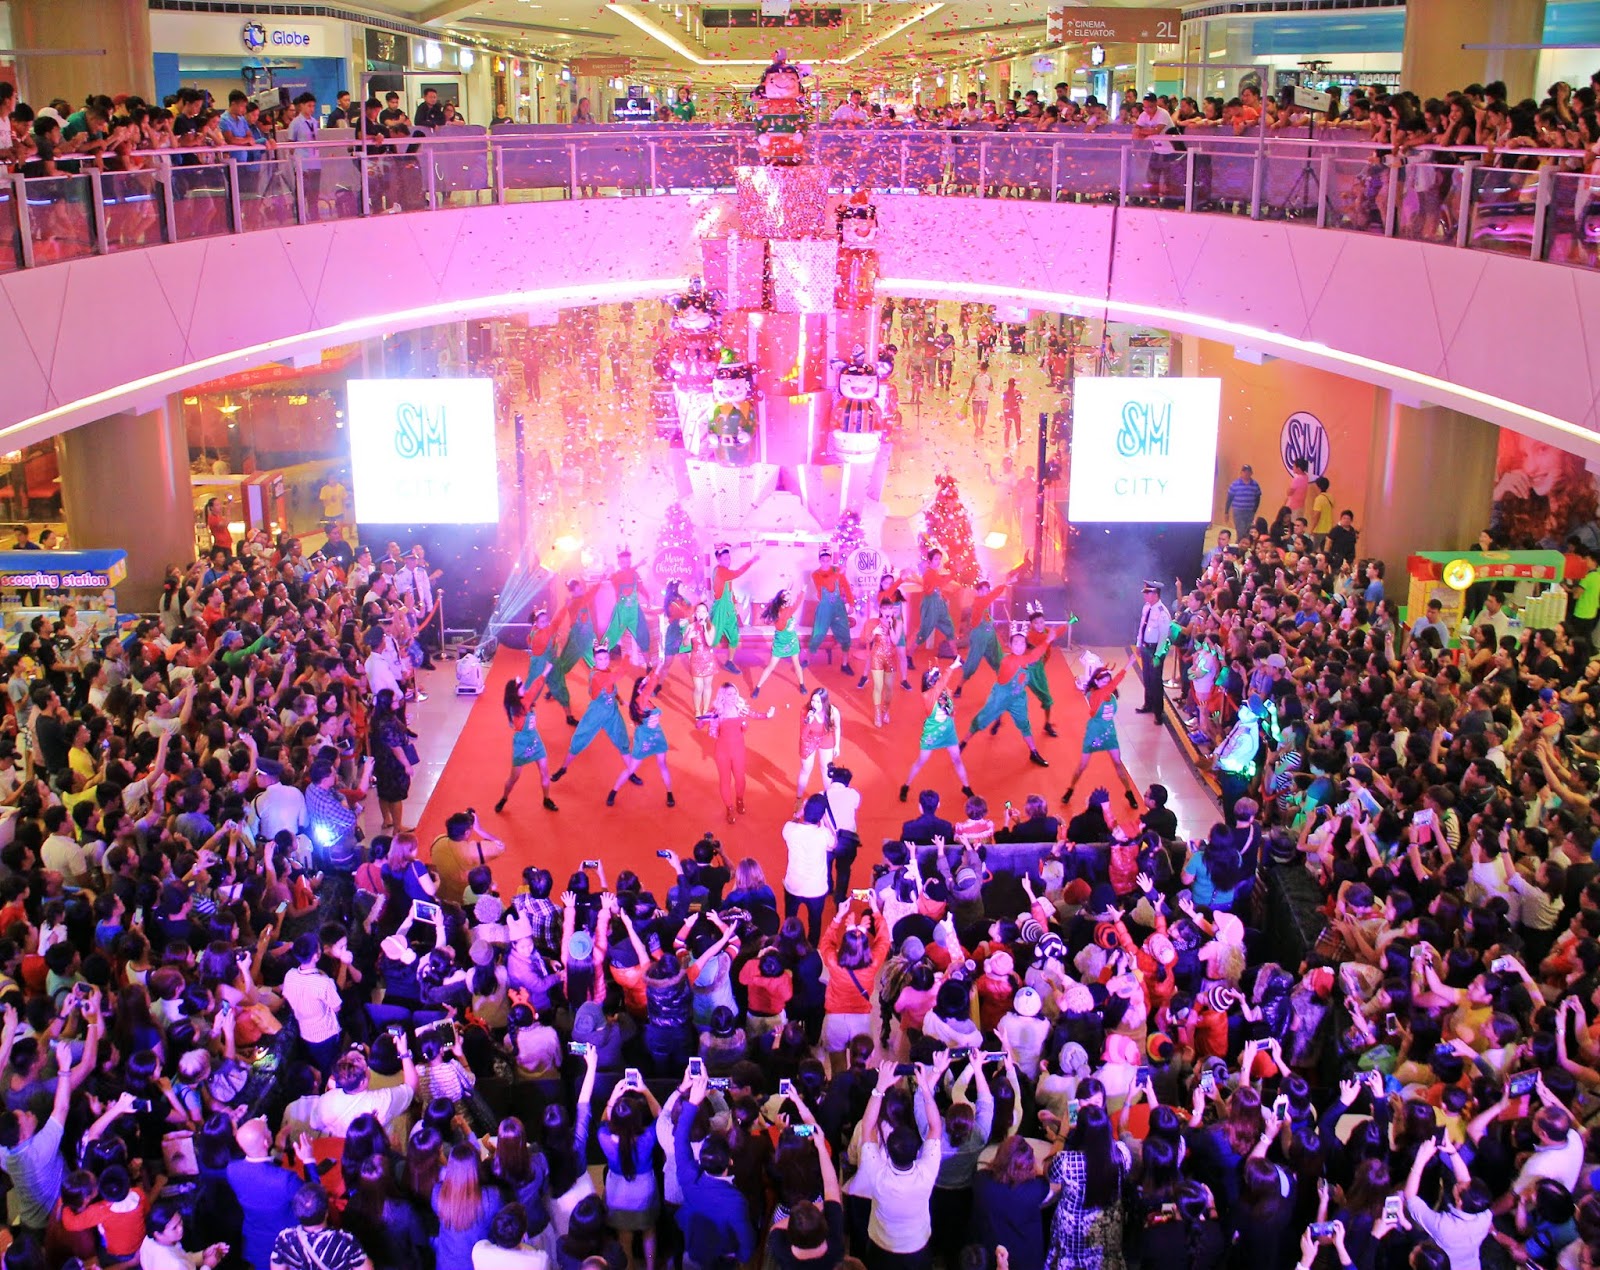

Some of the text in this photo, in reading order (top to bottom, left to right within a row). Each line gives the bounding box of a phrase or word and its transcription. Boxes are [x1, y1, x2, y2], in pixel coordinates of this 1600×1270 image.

[272, 31, 310, 45] Globe
[1074, 29, 1115, 37] ELEVATOR
[1155, 21, 1177, 38] 2L
[572, 65, 583, 75] 2L
[395, 401, 448, 459] SM
[1117, 400, 1171, 457] SM
[1285, 419, 1323, 476] SM
[1114, 477, 1169, 496] CITY
[857, 551, 877, 571] SM
[1, 571, 108, 588] scooping station
